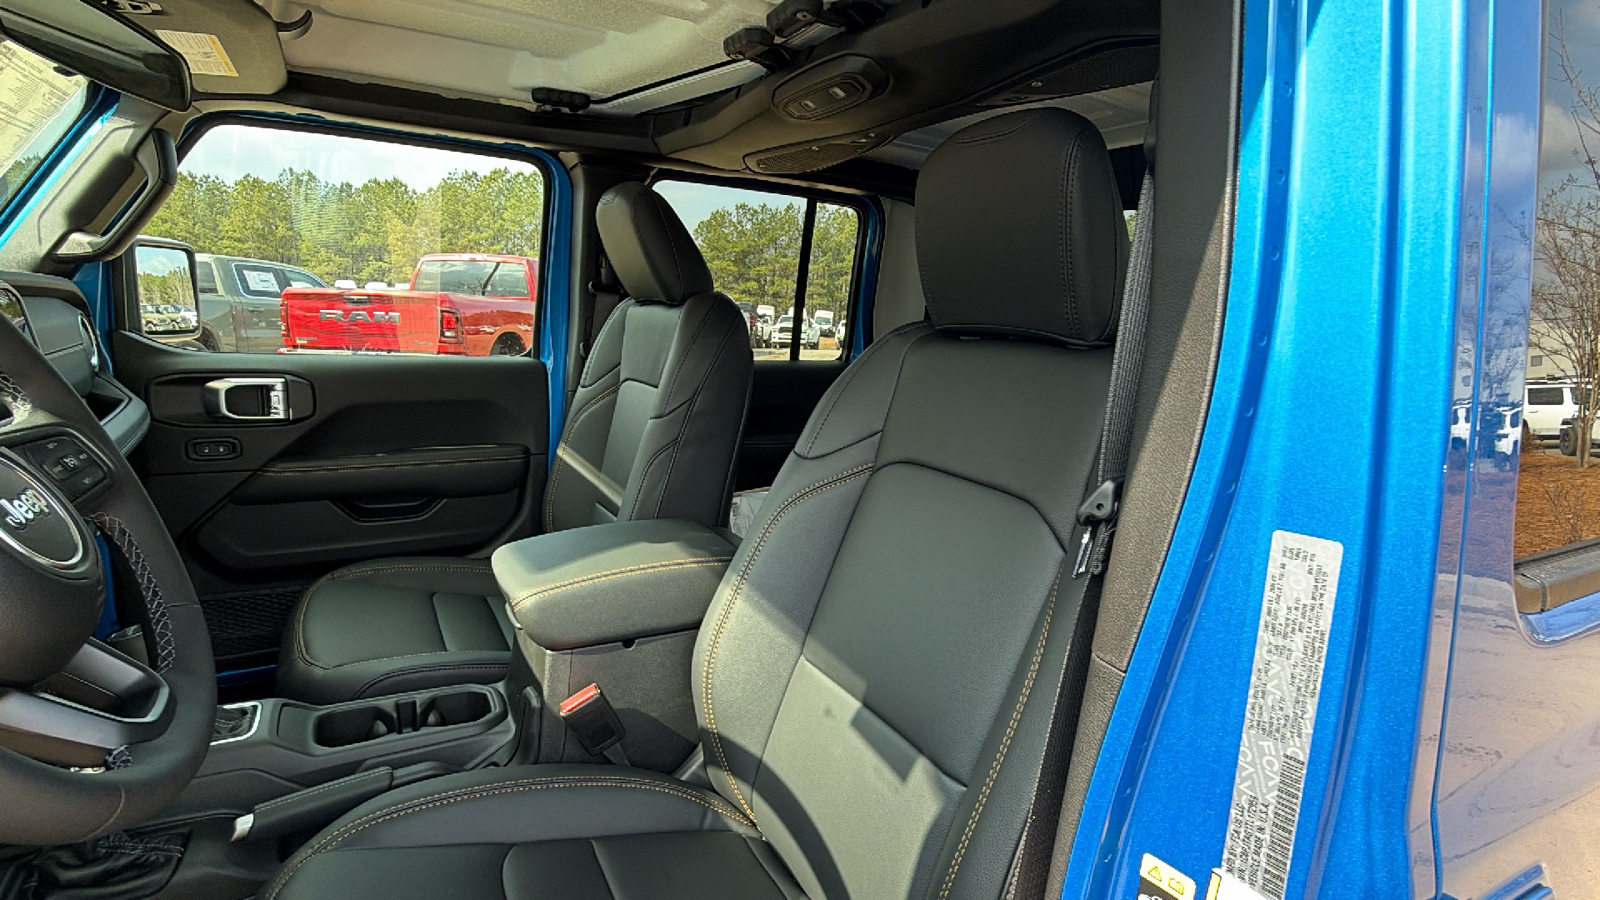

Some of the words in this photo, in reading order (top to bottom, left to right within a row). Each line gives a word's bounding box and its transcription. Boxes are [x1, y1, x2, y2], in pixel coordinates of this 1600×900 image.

[319, 309, 400, 323] RAM
[0, 489, 49, 527] Jeep
[1236, 802, 1245, 818] LLC
[1233, 816, 1242, 829] US
[1231, 828, 1240, 843] FCA
[1252, 834, 1264, 857] MADE
[1226, 857, 1236, 875] MFD
[1248, 856, 1260, 887] VEHICLE
